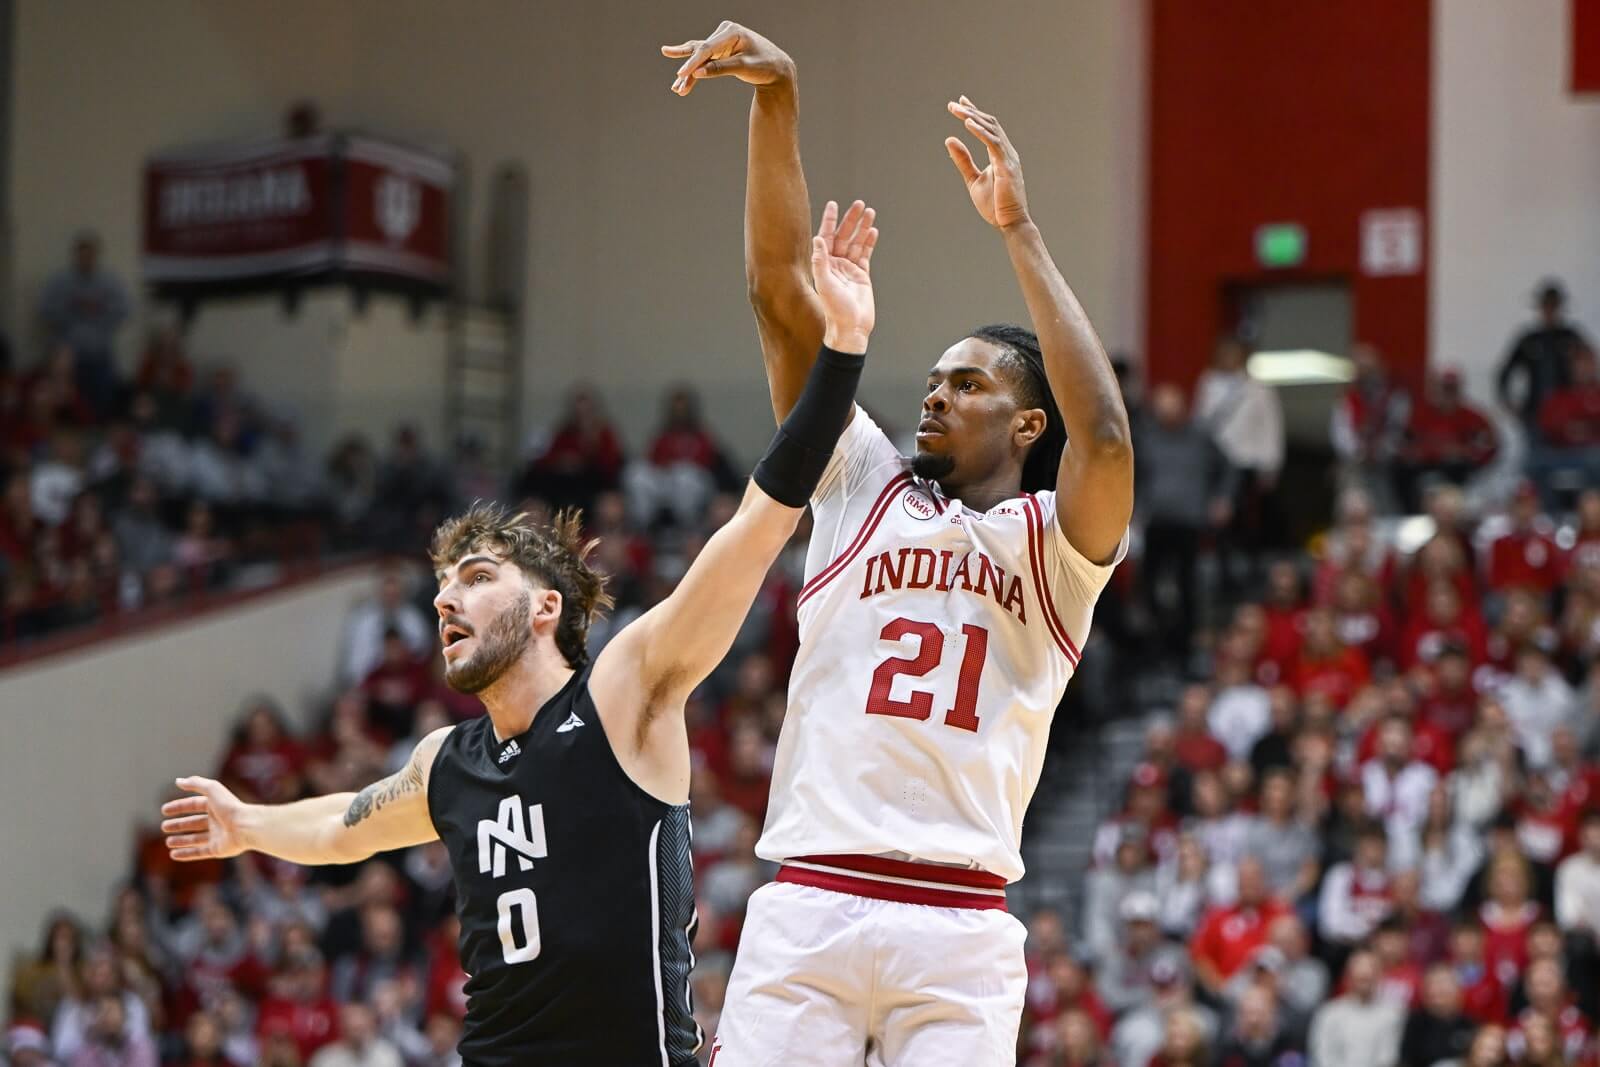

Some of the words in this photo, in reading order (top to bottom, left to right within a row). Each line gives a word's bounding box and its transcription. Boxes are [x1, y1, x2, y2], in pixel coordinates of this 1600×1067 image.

[906, 495, 931, 517] RMK
[860, 548, 1026, 625] INDIANA
[865, 617, 988, 733] 21
[497, 888, 541, 965] 0
